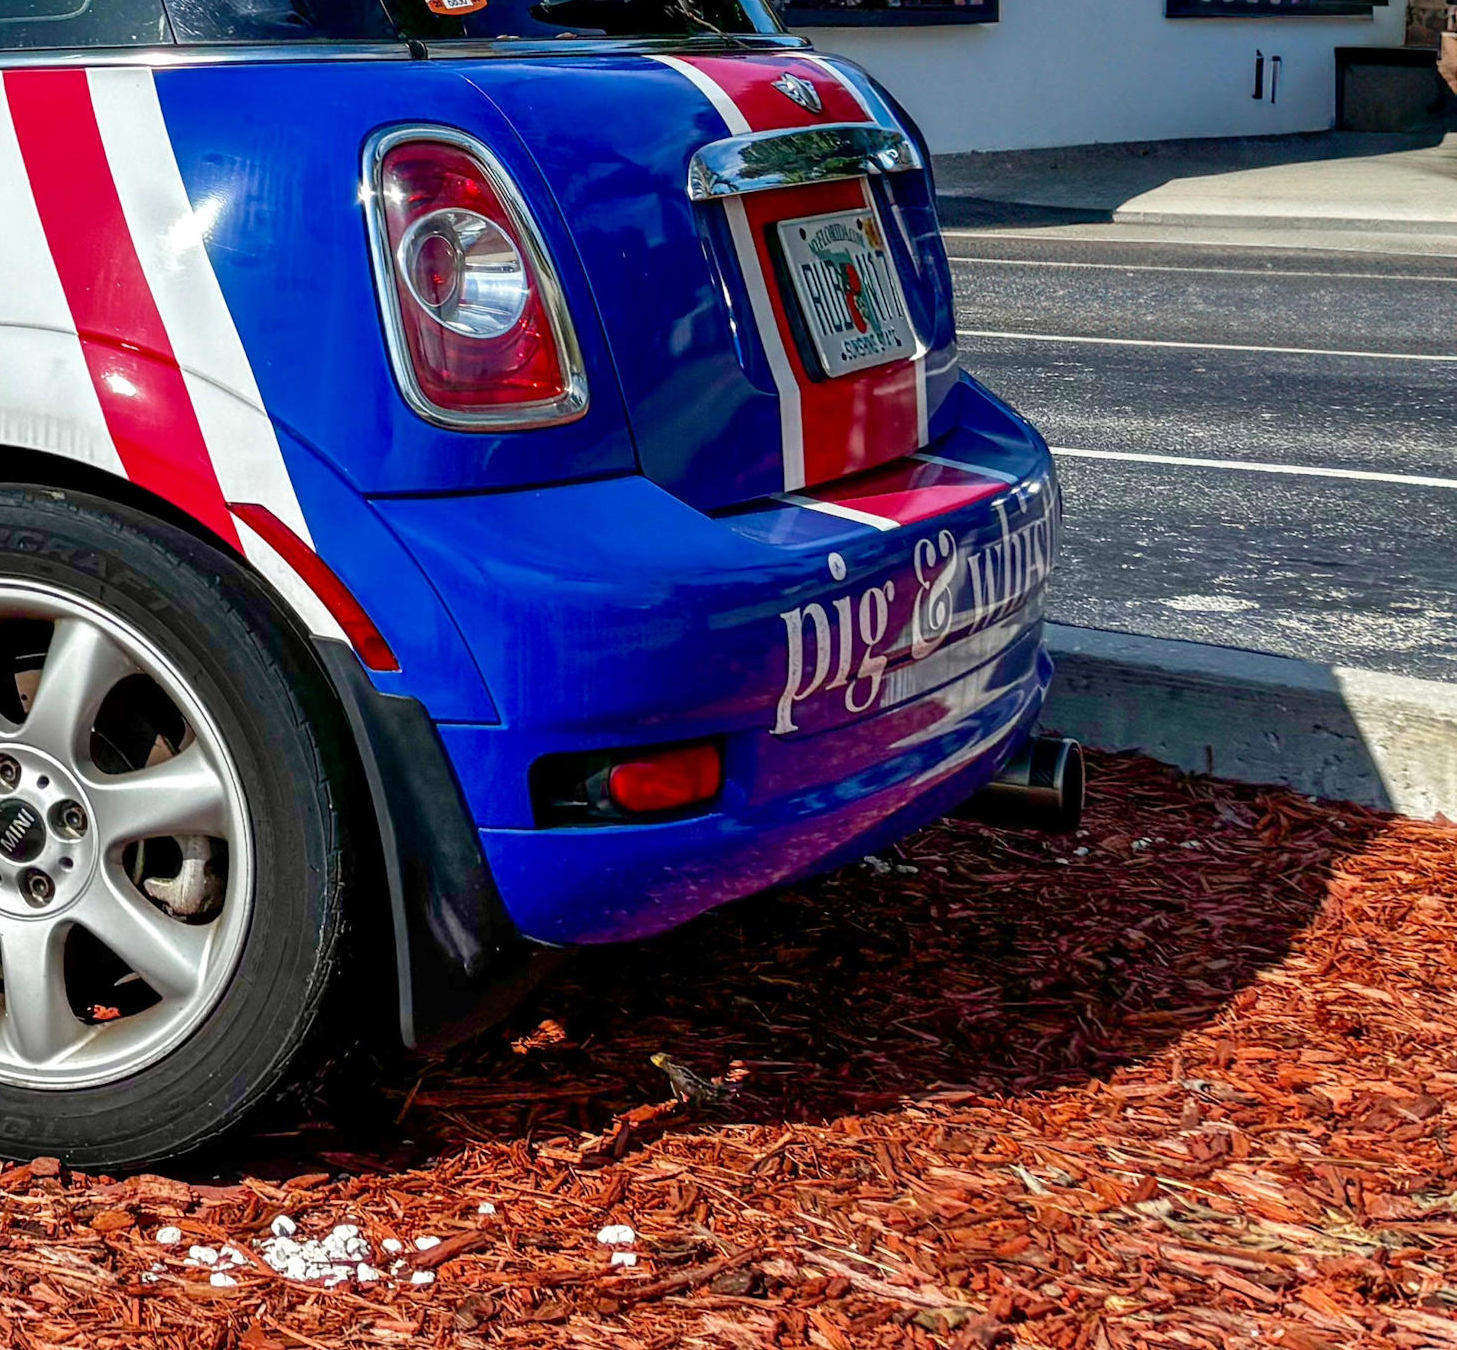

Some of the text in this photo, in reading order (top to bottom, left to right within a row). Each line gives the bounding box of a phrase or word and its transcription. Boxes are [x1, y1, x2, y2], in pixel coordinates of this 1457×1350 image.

[770, 552, 895, 734] pig
[911, 529, 957, 660] &
[0, 808, 35, 852] MINI
